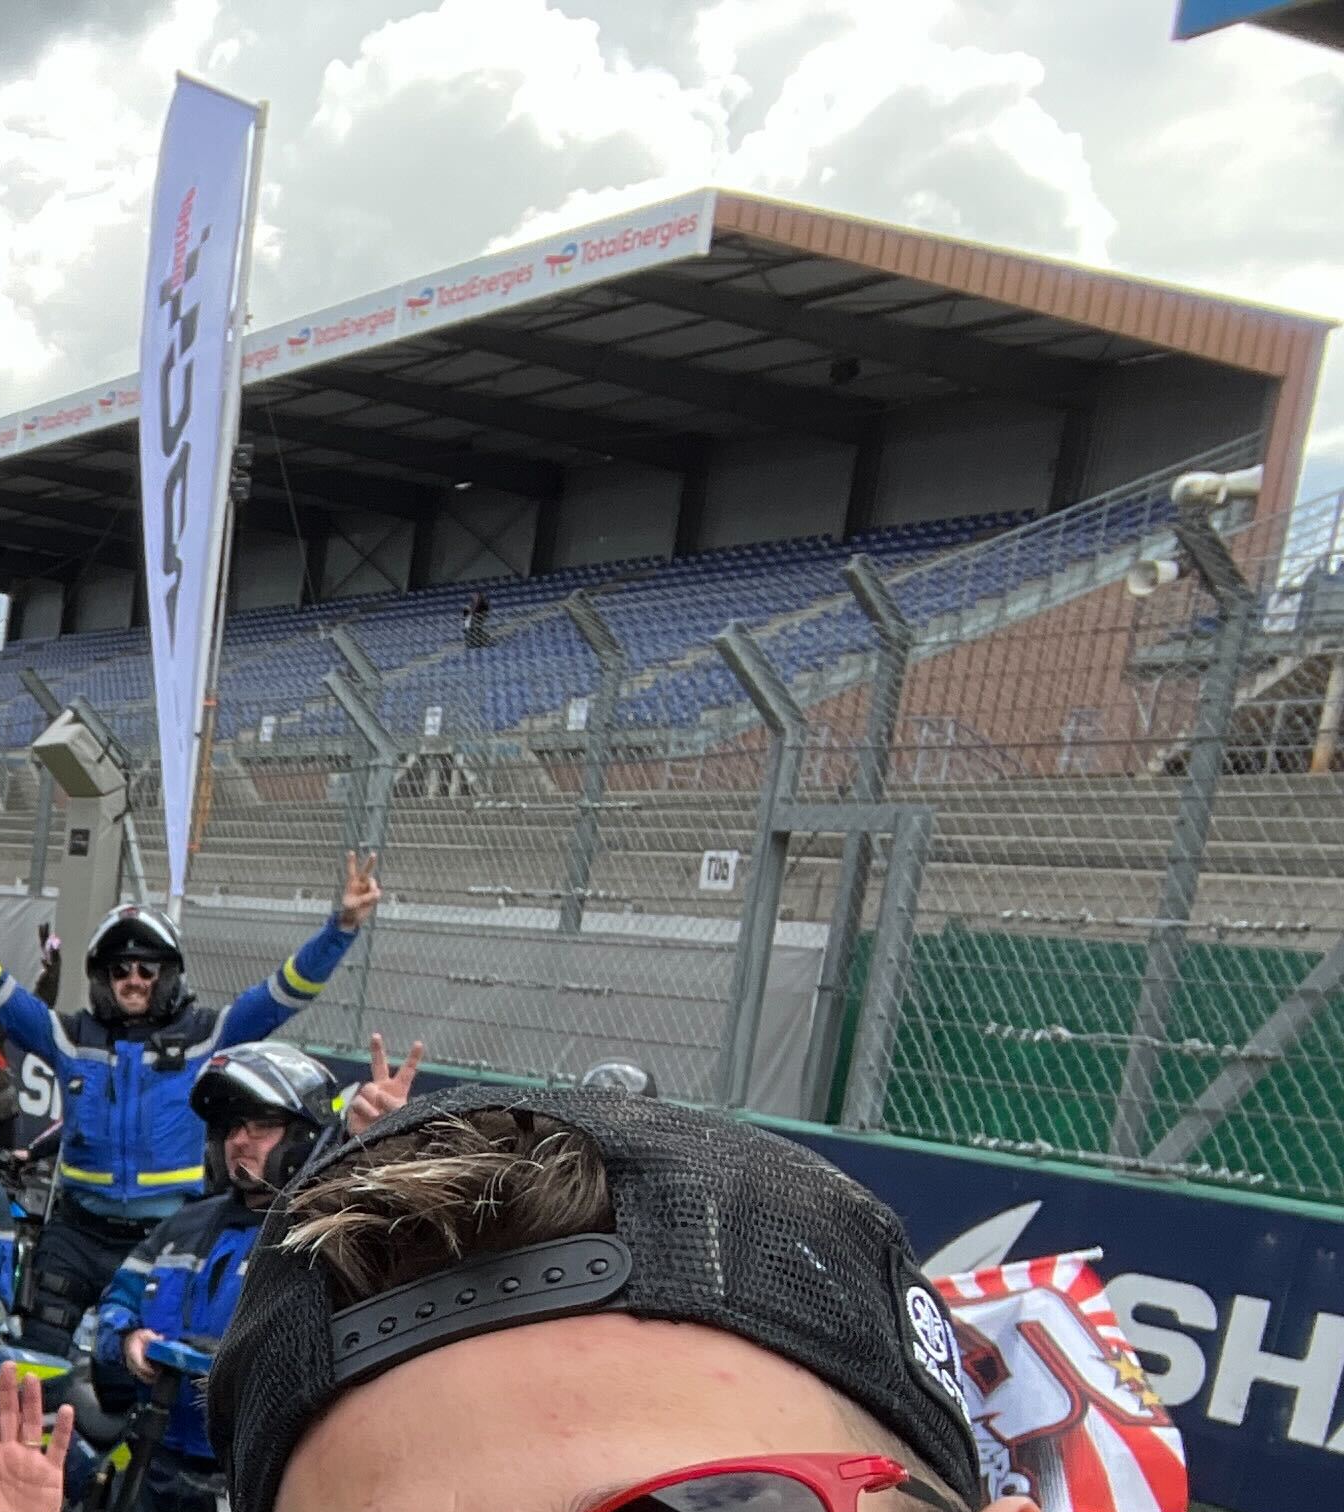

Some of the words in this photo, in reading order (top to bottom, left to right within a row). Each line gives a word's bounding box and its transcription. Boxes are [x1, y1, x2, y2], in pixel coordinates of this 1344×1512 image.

[579, 212, 698, 265] TotalEnergies
[436, 261, 534, 309] TotalEnergies
[18, 1053, 64, 1120] S
[1105, 1271, 1344, 1454] SH
